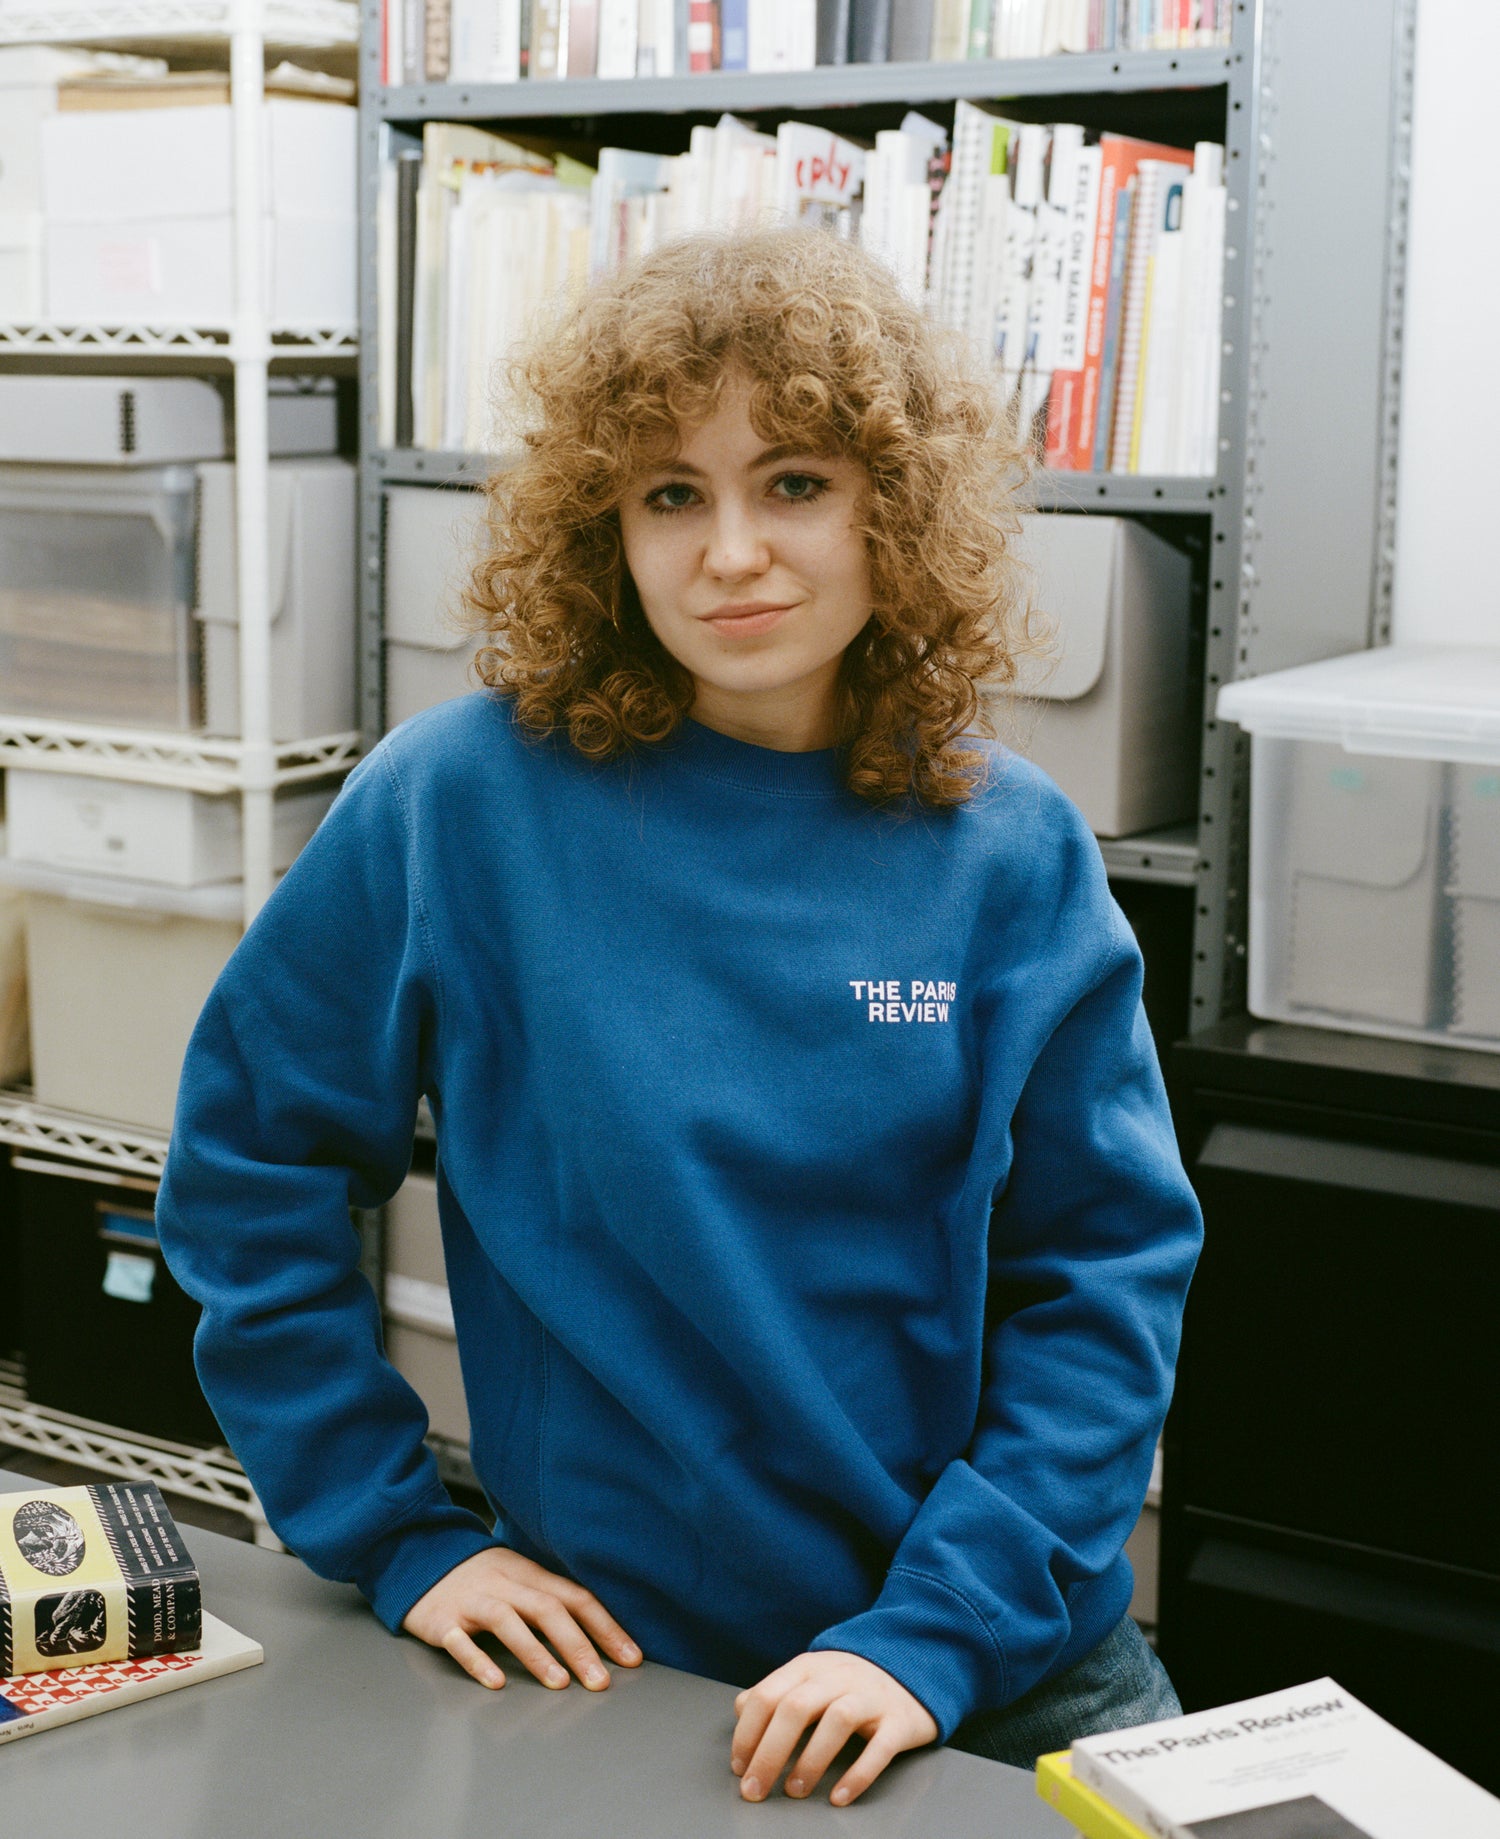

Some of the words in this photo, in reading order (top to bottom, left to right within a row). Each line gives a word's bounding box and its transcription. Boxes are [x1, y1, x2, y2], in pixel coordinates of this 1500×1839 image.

[1071, 231, 1084, 261] ON
[1062, 334, 1075, 357] ST
[849, 980, 901, 1001] THE
[911, 980, 957, 1002] PARIS
[868, 1002, 949, 1023] REVIEW
[152, 1579, 162, 1608] MEAD
[165, 1578, 176, 1630] COMPANY
[153, 1610, 163, 1641] DODD,
[167, 1632, 176, 1640] &
[1103, 1745, 1161, 1764] The
[1158, 1727, 1240, 1752] Paris
[1237, 1698, 1345, 1733] Review
